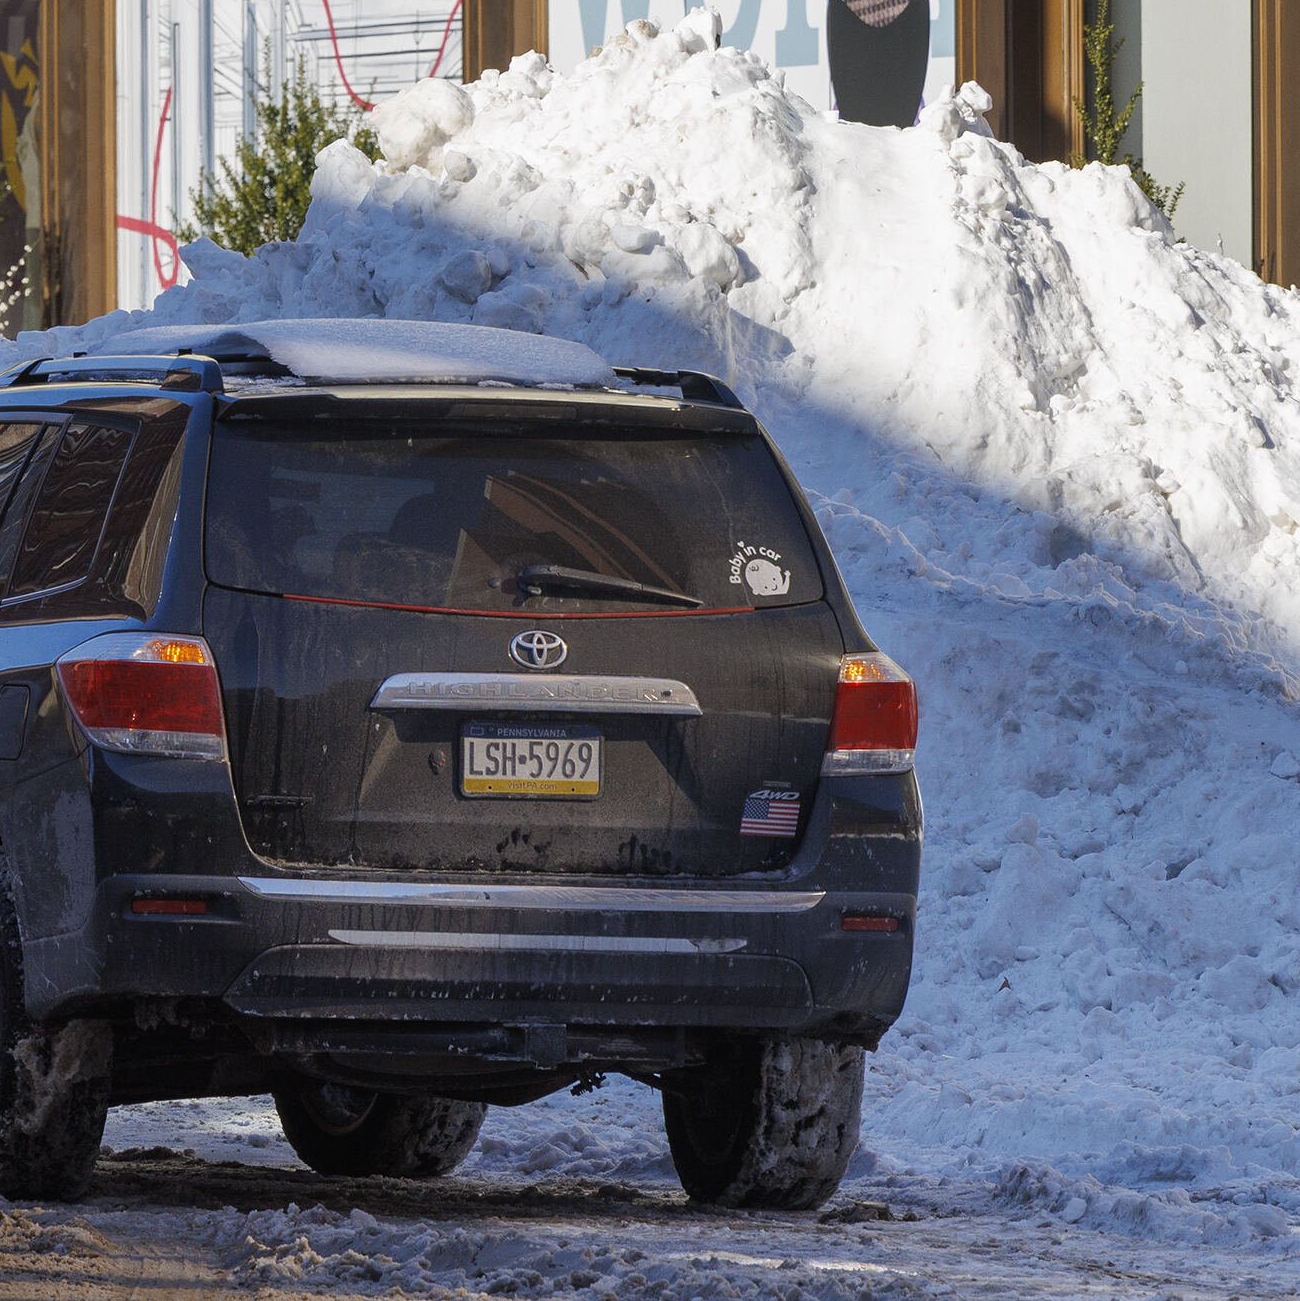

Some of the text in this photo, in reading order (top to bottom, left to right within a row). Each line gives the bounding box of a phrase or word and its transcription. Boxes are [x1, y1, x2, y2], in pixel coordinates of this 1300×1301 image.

[728, 543, 782, 584] Baby in car
[408, 681, 660, 701] HIGHLANDER
[497, 727, 567, 738] PENNSYLVANIA
[749, 789, 800, 800] 4WD
